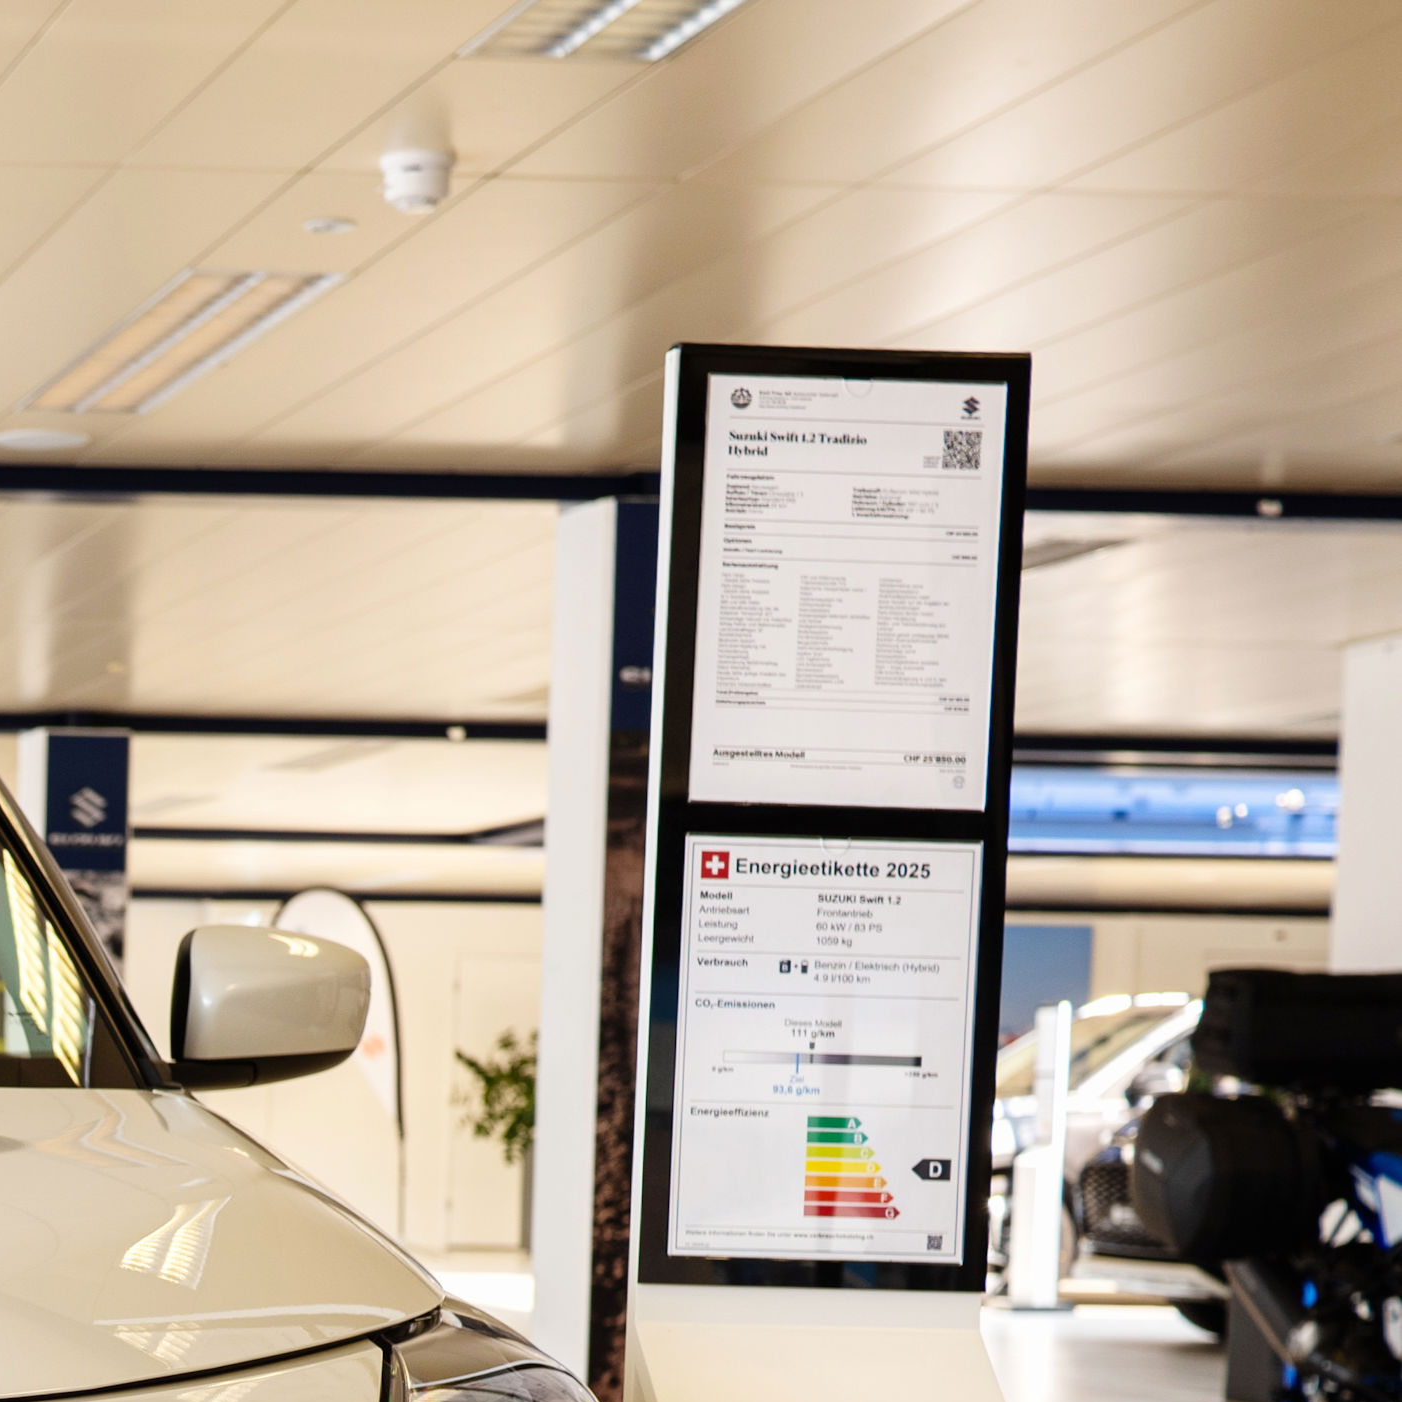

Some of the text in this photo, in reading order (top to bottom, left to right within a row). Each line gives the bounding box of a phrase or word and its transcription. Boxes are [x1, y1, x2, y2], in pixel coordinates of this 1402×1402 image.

[729, 431, 768, 442] Suzuki
[770, 432, 799, 443] Swift
[820, 433, 868, 445] Tradizio
[728, 445, 768, 457] Hybrid
[712, 749, 806, 760] Ausgestelltes Modell
[903, 755, 920, 763] CHF
[736, 858, 931, 879] Energieetikette 2025
[700, 890, 733, 901] Modell
[818, 894, 902, 906] SUZUKI Swift 1.2
[699, 905, 750, 916] Antriebsart
[816, 907, 874, 919] Frontantrieb
[698, 919, 738, 931] Leistung
[830, 923, 846, 933] kW
[869, 924, 883, 933] PS
[697, 933, 755, 945] Leergewicht
[841, 936, 853, 948] kg
[697, 957, 749, 968] Verbrauch
[814, 960, 847, 971] Benzin
[855, 961, 900, 972] Elektrisch
[902, 962, 941, 974] (Hybrid)
[856, 974, 871, 984] km
[815, 1019, 843, 1029] Modell
[792, 1029, 835, 1040] 111 g/km
[795, 1086, 821, 1097] g/km
[690, 1107, 770, 1119] Energieeffizienz
[847, 1118, 857, 1129] A
[854, 1133, 863, 1144] B
[928, 1161, 943, 1177] D
[881, 1192, 888, 1203] F
[885, 1207, 895, 1219] G
